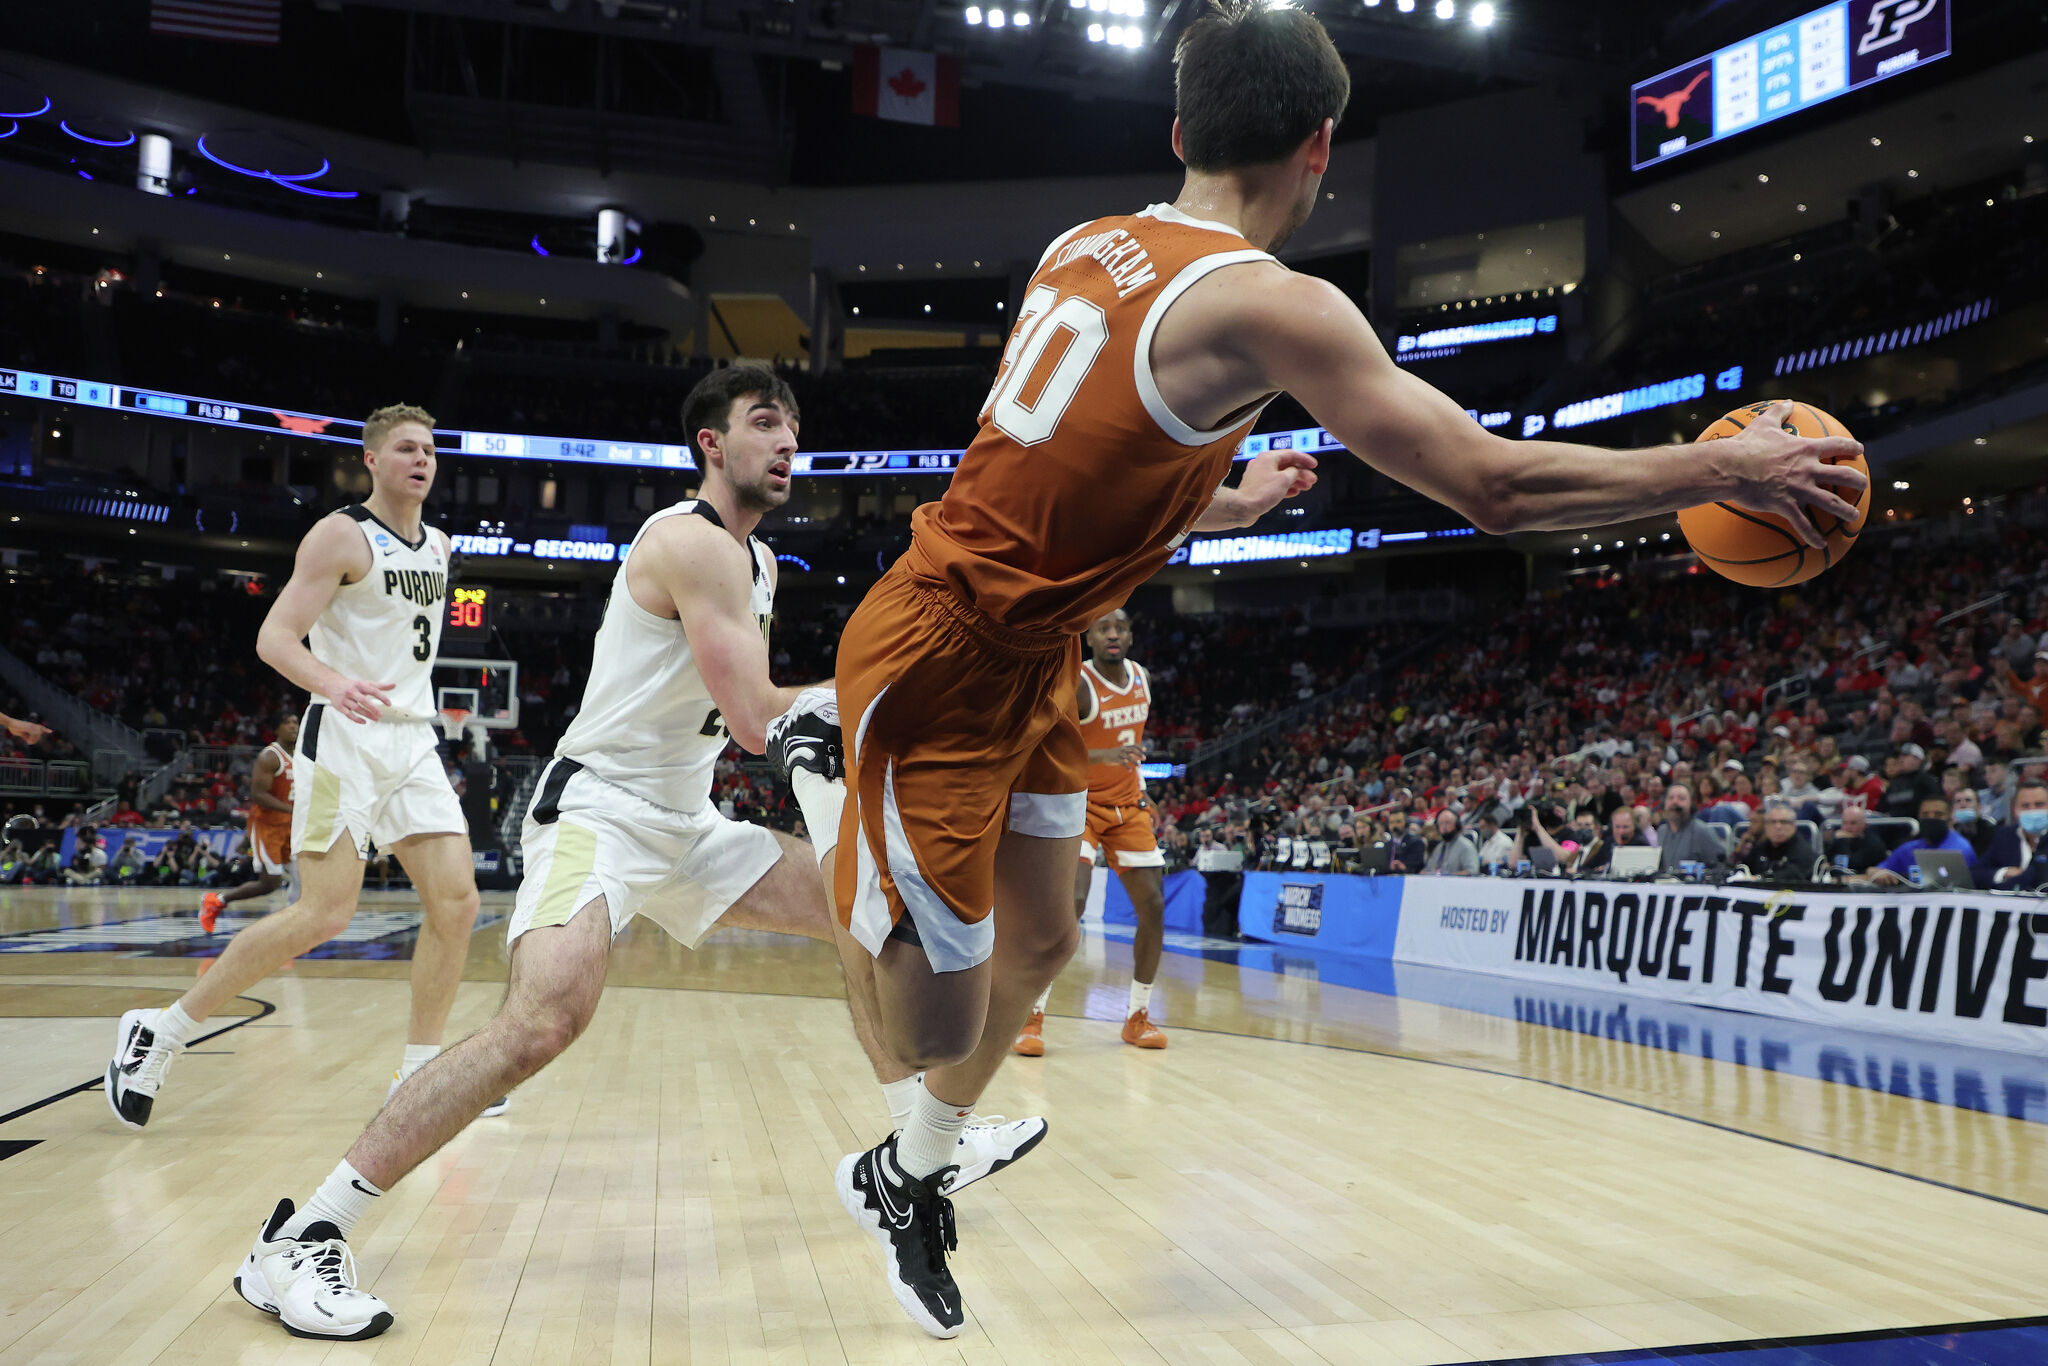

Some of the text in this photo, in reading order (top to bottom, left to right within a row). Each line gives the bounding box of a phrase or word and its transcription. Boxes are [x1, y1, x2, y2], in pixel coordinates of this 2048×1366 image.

[485, 437, 507, 451] 50
[451, 535, 513, 555] FIRST
[533, 540, 616, 562] SECOND
[450, 601, 483, 628] 30
[413, 615, 431, 662] 3
[1101, 704, 1149, 730] TEXAS
[1440, 906, 1489, 933] HOSTED
[1490, 909, 1509, 934] BY
[1514, 888, 1807, 984] MARQUETTE
